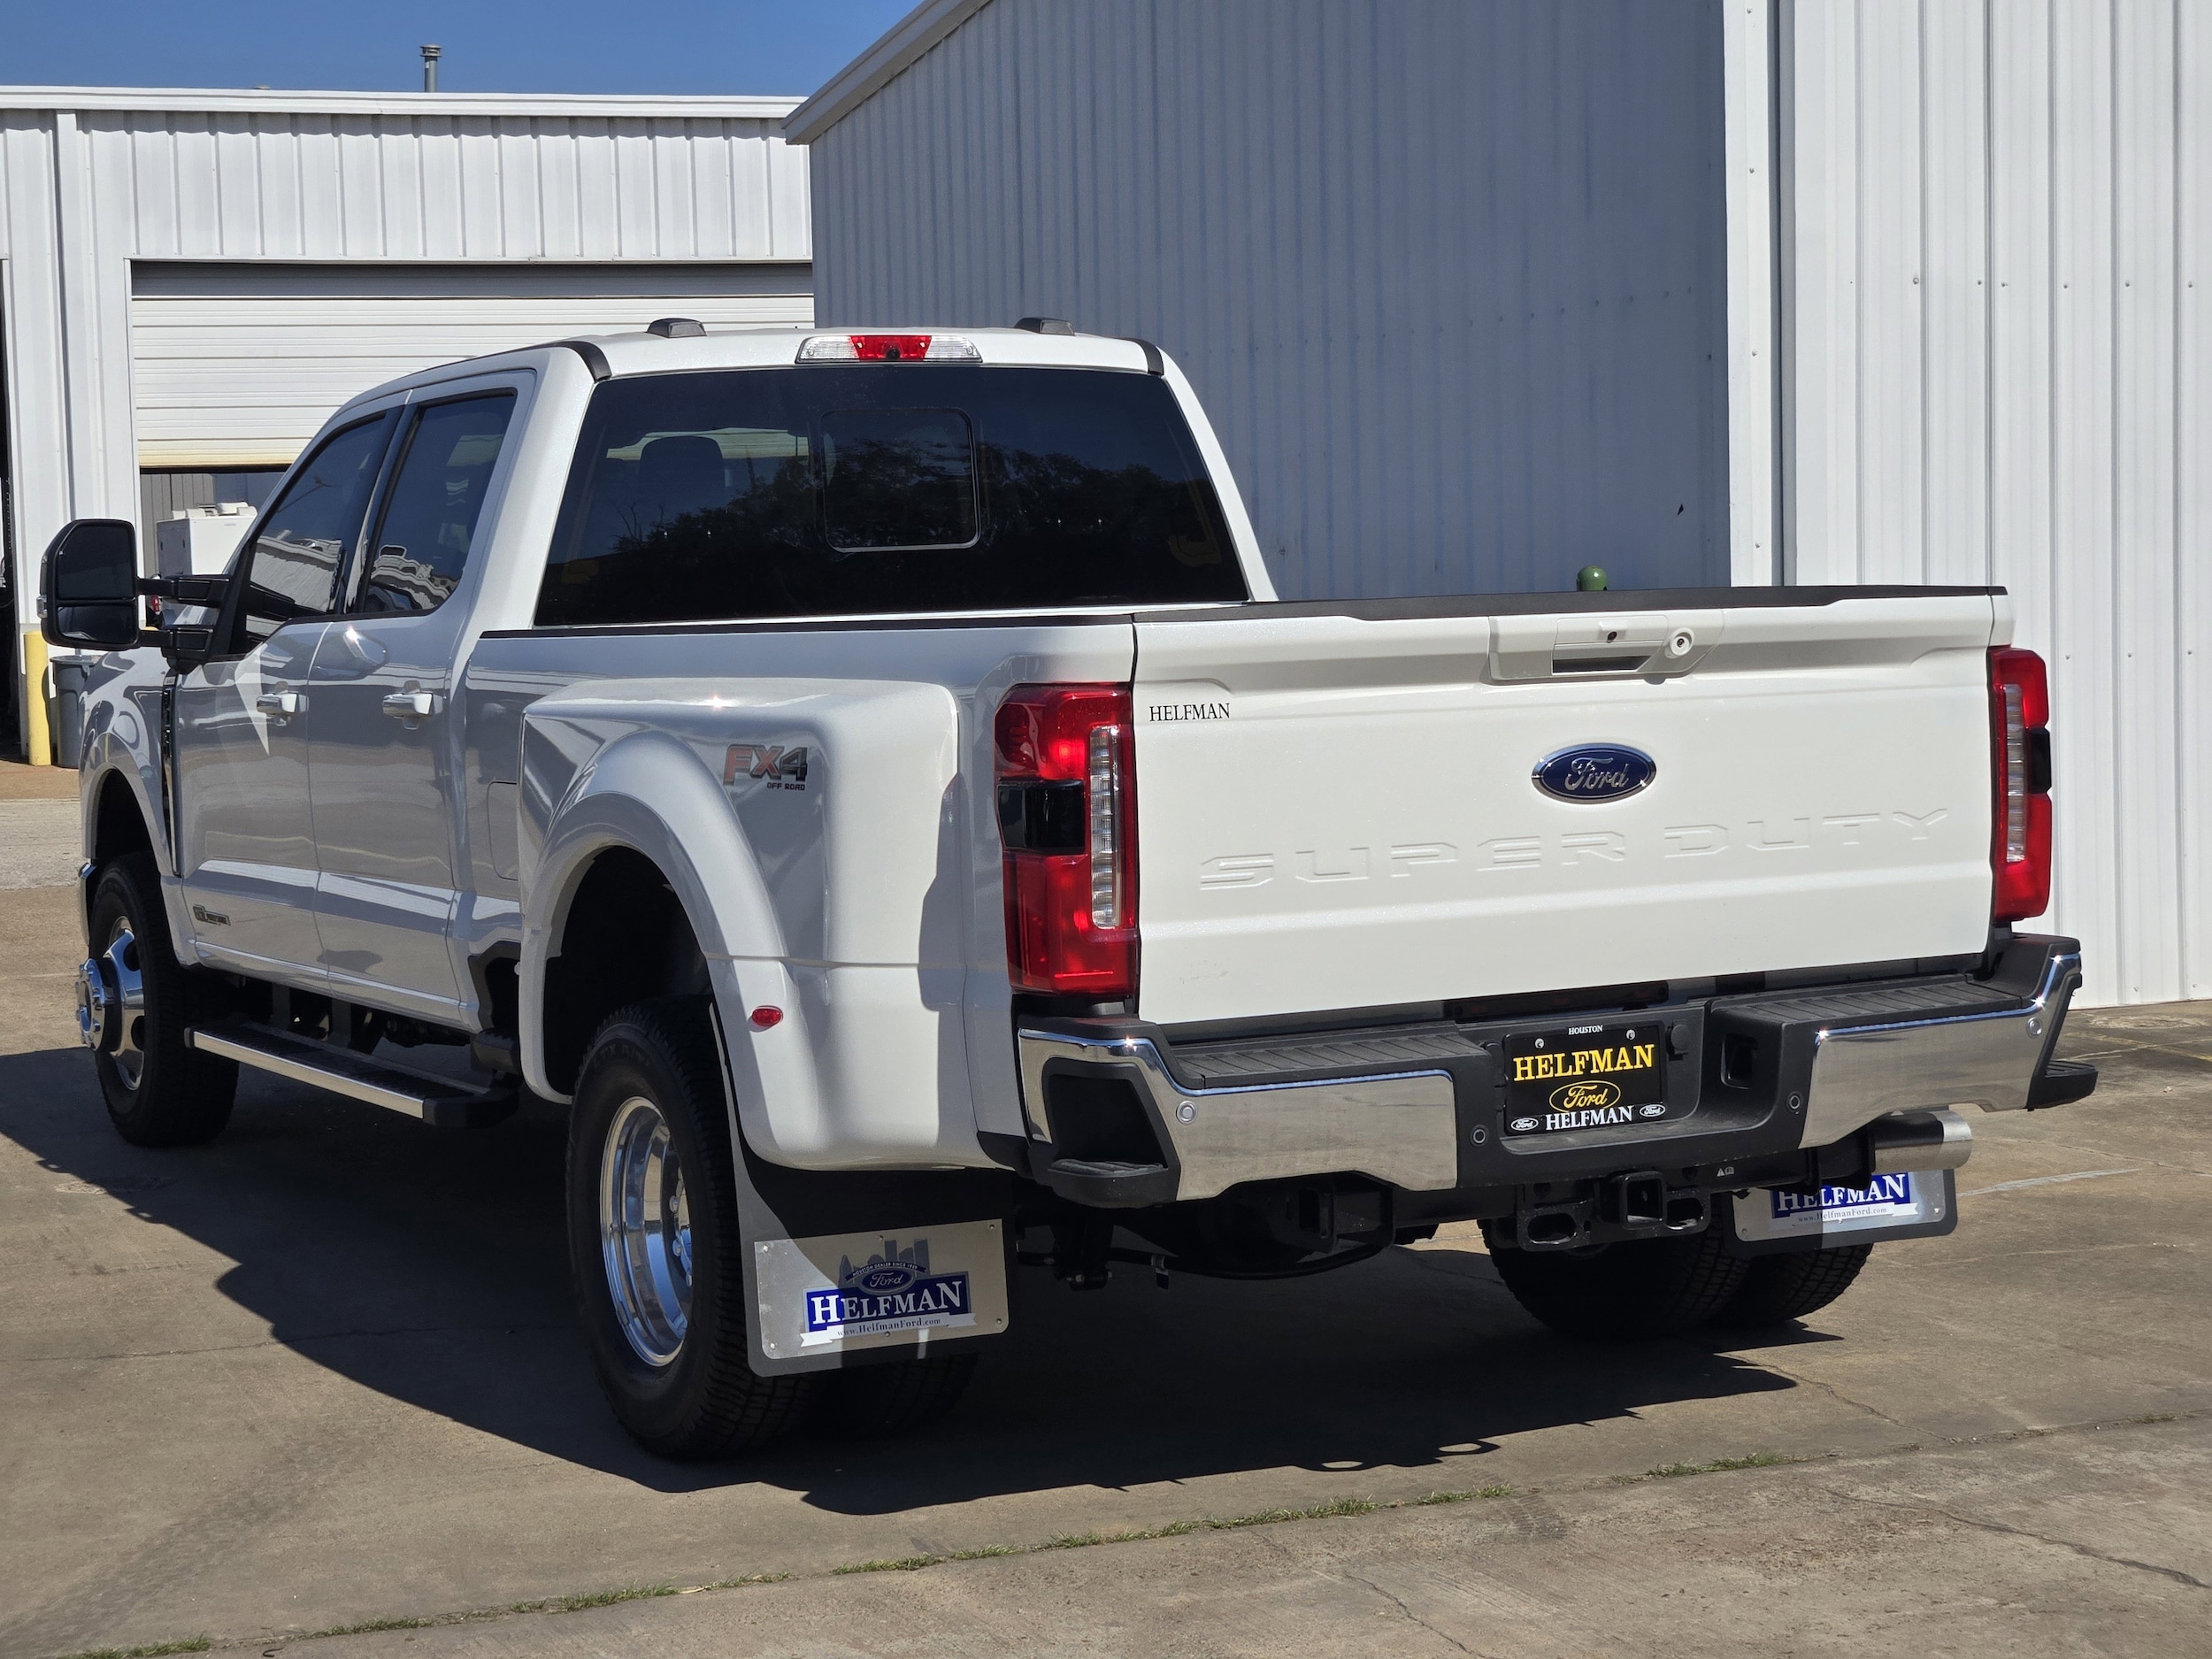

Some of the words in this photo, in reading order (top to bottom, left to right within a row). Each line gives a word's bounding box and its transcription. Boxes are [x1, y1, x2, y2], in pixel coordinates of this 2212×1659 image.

[1148, 703, 1231, 722] HELFMAN
[723, 744, 808, 786] FX4
[1564, 757, 1630, 791] Ford
[1200, 831, 1625, 891] SUPER
[1663, 808, 1948, 858] DUTY
[1568, 1025, 1603, 1035] HOUSTON
[1512, 1043, 1655, 1082] HELFMAN
[1563, 1084, 1609, 1109] Ford
[1545, 1105, 1634, 1131] HELFMAN
[1798, 1207, 1887, 1222] www.HelfmanFord.com
[869, 1271, 903, 1288] Ford
[810, 1281, 963, 1325] HELFMAN
[837, 1317, 941, 1336] www.HelfmanFord.com
